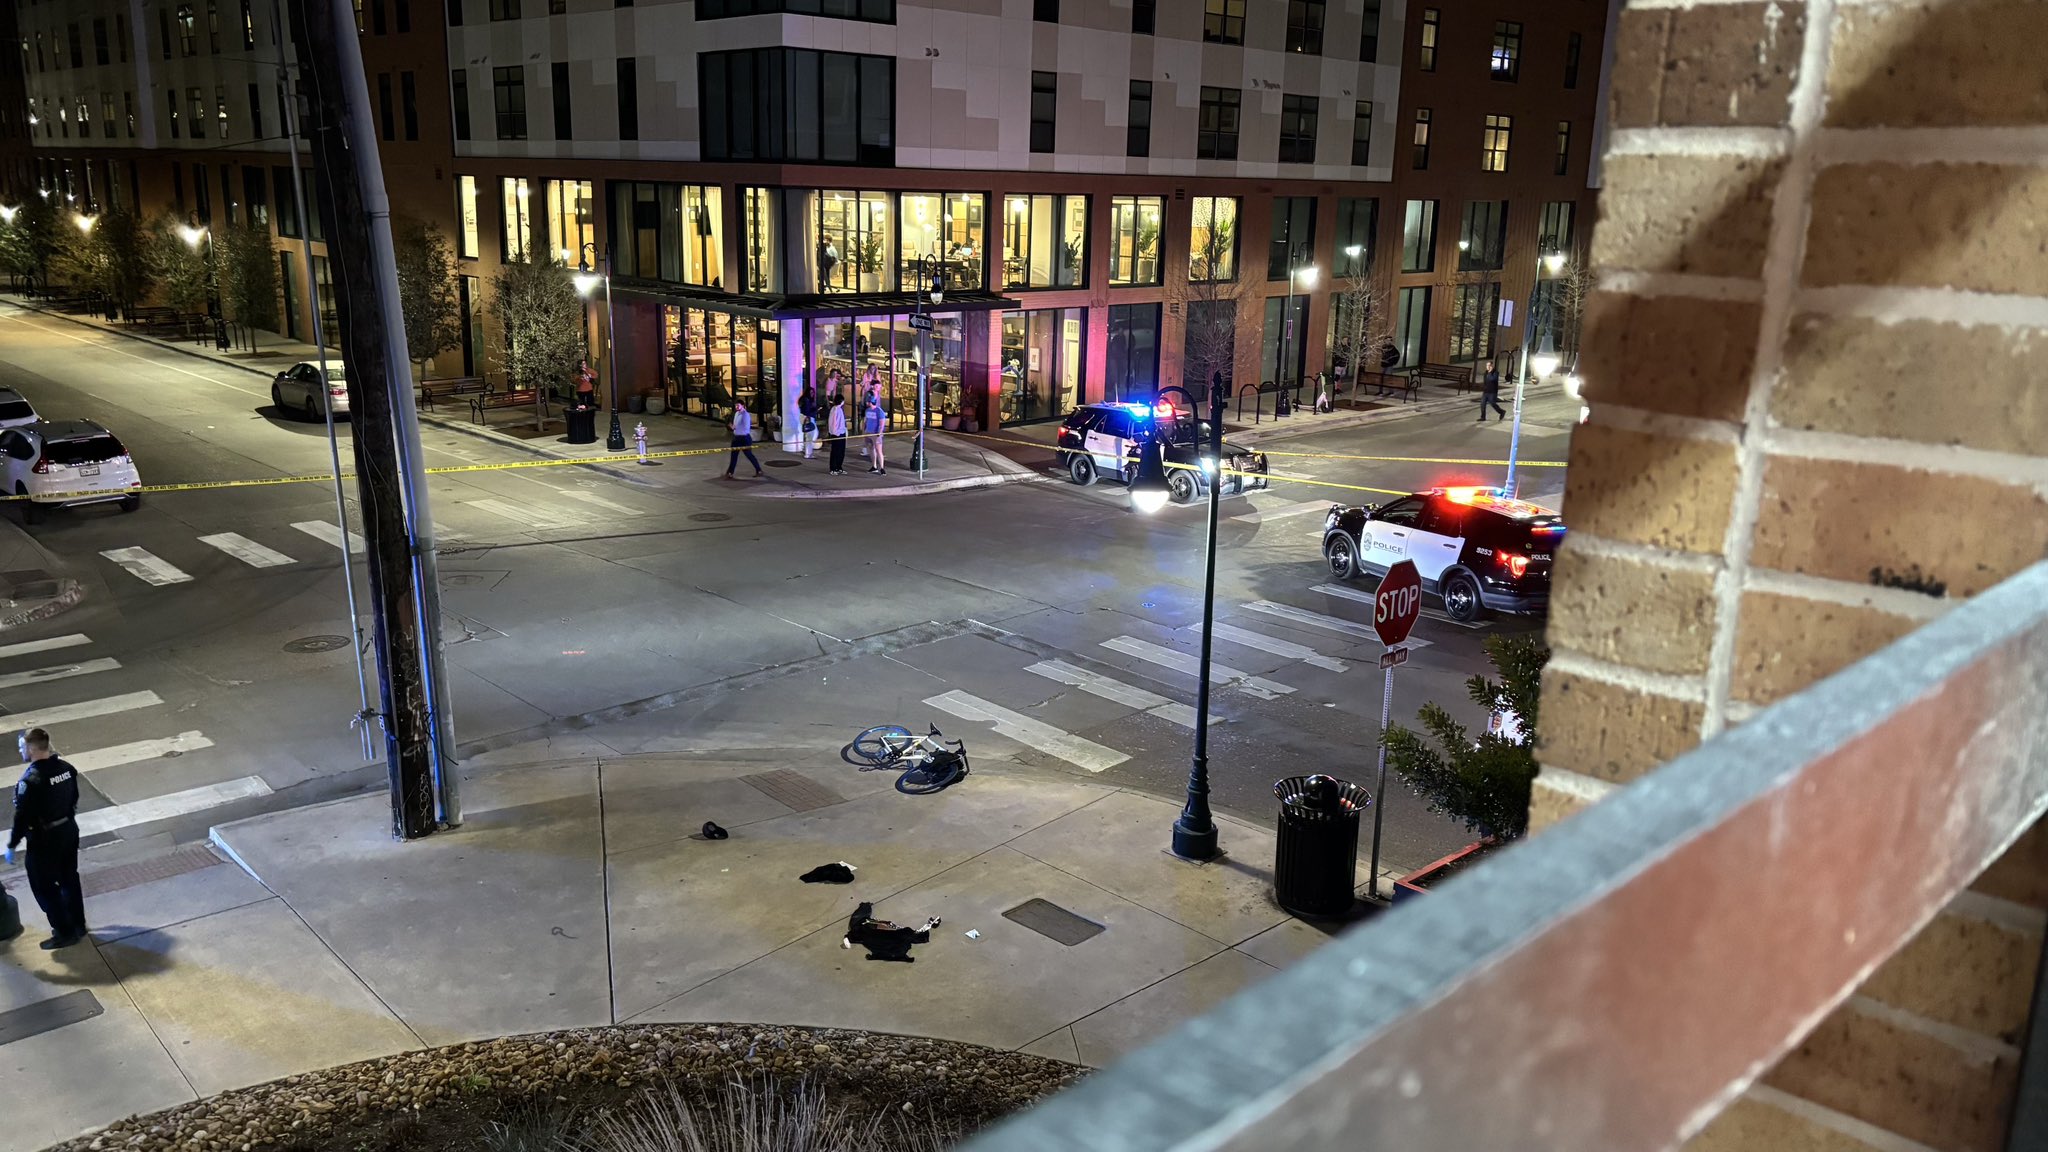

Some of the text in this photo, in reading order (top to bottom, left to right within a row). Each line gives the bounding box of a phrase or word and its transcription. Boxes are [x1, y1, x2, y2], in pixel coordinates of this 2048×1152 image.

[1373, 540, 1404, 552] POLICE
[1531, 553, 1551, 561] POLICE
[1377, 584, 1419, 623] STOP
[50, 771, 71, 785] POLICE
